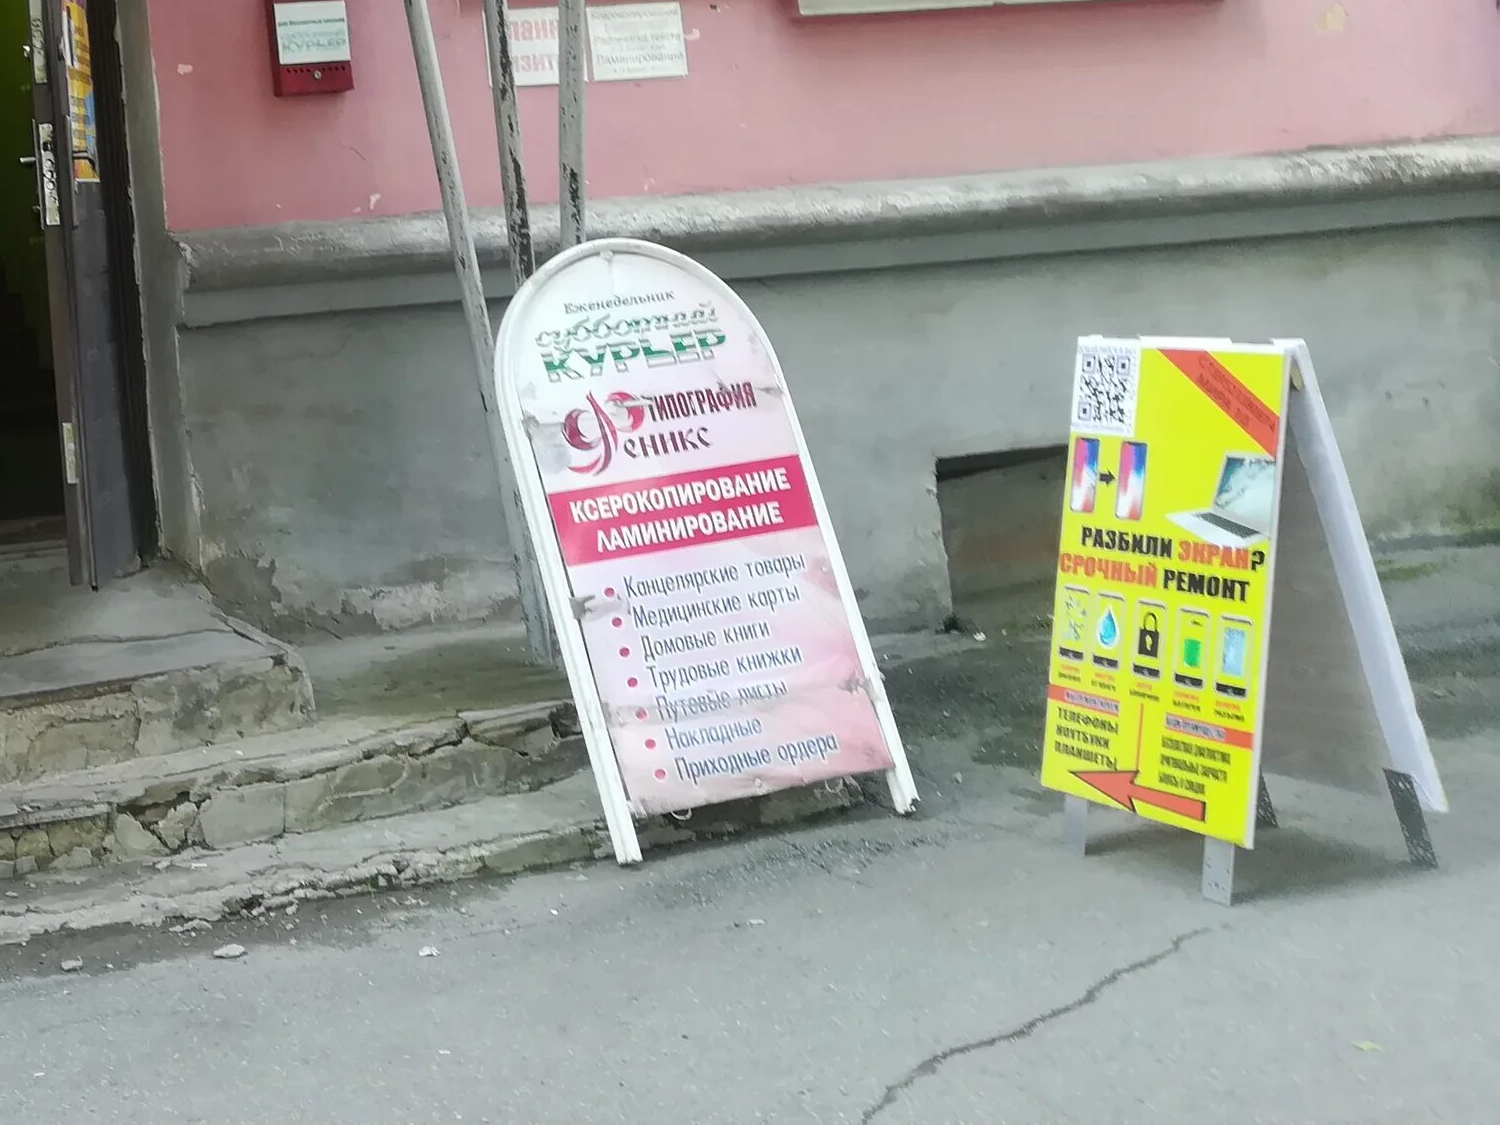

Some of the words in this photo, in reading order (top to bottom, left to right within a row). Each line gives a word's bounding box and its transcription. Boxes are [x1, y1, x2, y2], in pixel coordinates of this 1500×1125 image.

[540, 326, 727, 383] КУРЬЕР
[569, 466, 792, 524] КСЕРОКОПИРОВАНИЕ
[596, 500, 784, 554] ЛАМИНИРОВАНИЕ
[1081, 525, 1172, 559] РАЗБИЛИ
[623, 565, 740, 600] Канцелярские
[746, 553, 806, 579] товары
[1059, 552, 1158, 588] СРОЧНЫЙ
[1163, 568, 1250, 603] РЕМОНТ
[631, 594, 742, 630] Медицинские
[747, 585, 801, 615] карты
[641, 630, 718, 663] Домовые
[723, 620, 771, 644] книги
[646, 657, 731, 694] Трудовые
[736, 644, 802, 675] книжки
[655, 687, 731, 723] Путевые
[664, 716, 763, 751] Накладные
[673, 741, 772, 786] Приходные
[777, 733, 838, 764] ордера
